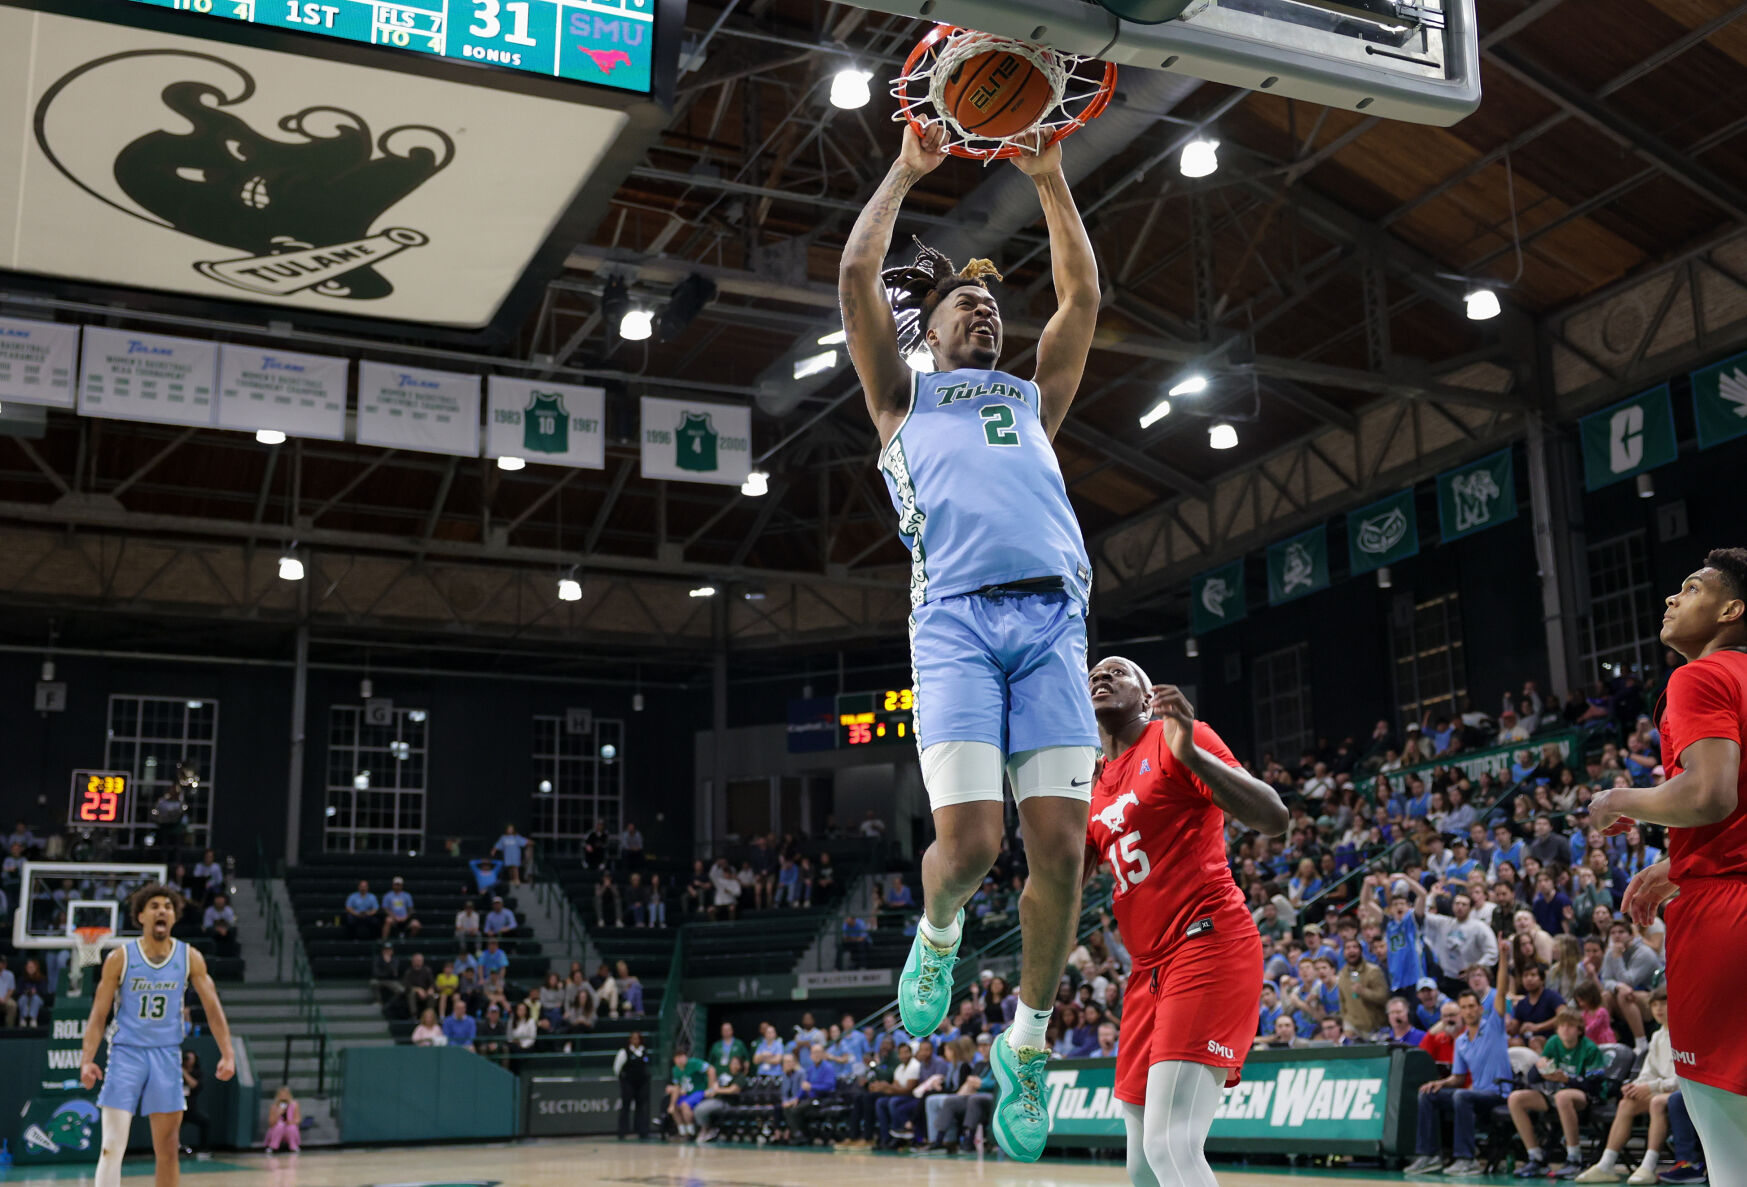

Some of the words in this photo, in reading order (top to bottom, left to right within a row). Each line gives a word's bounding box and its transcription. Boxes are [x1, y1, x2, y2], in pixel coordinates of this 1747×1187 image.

[233, 4, 248, 20] 4
[286, 0, 340, 29] 1ST
[378, 7, 415, 28] FLS
[430, 16, 443, 33] 7
[469, 0, 537, 47] 31
[379, 26, 410, 47] TO
[427, 37, 442, 53] 4
[569, 12, 645, 47] SMU
[463, 44, 522, 66] BONUS
[968, 54, 1021, 111] ELITE
[235, 244, 375, 284] TULANE
[935, 381, 1031, 409] TULAN
[539, 416, 556, 435] 10
[979, 403, 1021, 447] 2
[849, 723, 872, 745] 35
[87, 775, 125, 794] 2:33
[80, 791, 118, 822] 23
[1108, 830, 1151, 894] 15
[129, 976, 179, 992] TULANE
[138, 992, 169, 1021] 13
[47, 1049, 84, 1070] WAV
[1207, 1039, 1234, 1060] SMU
[538, 1097, 610, 1114] SECTIONS
[1269, 1067, 1383, 1127] WAVE
